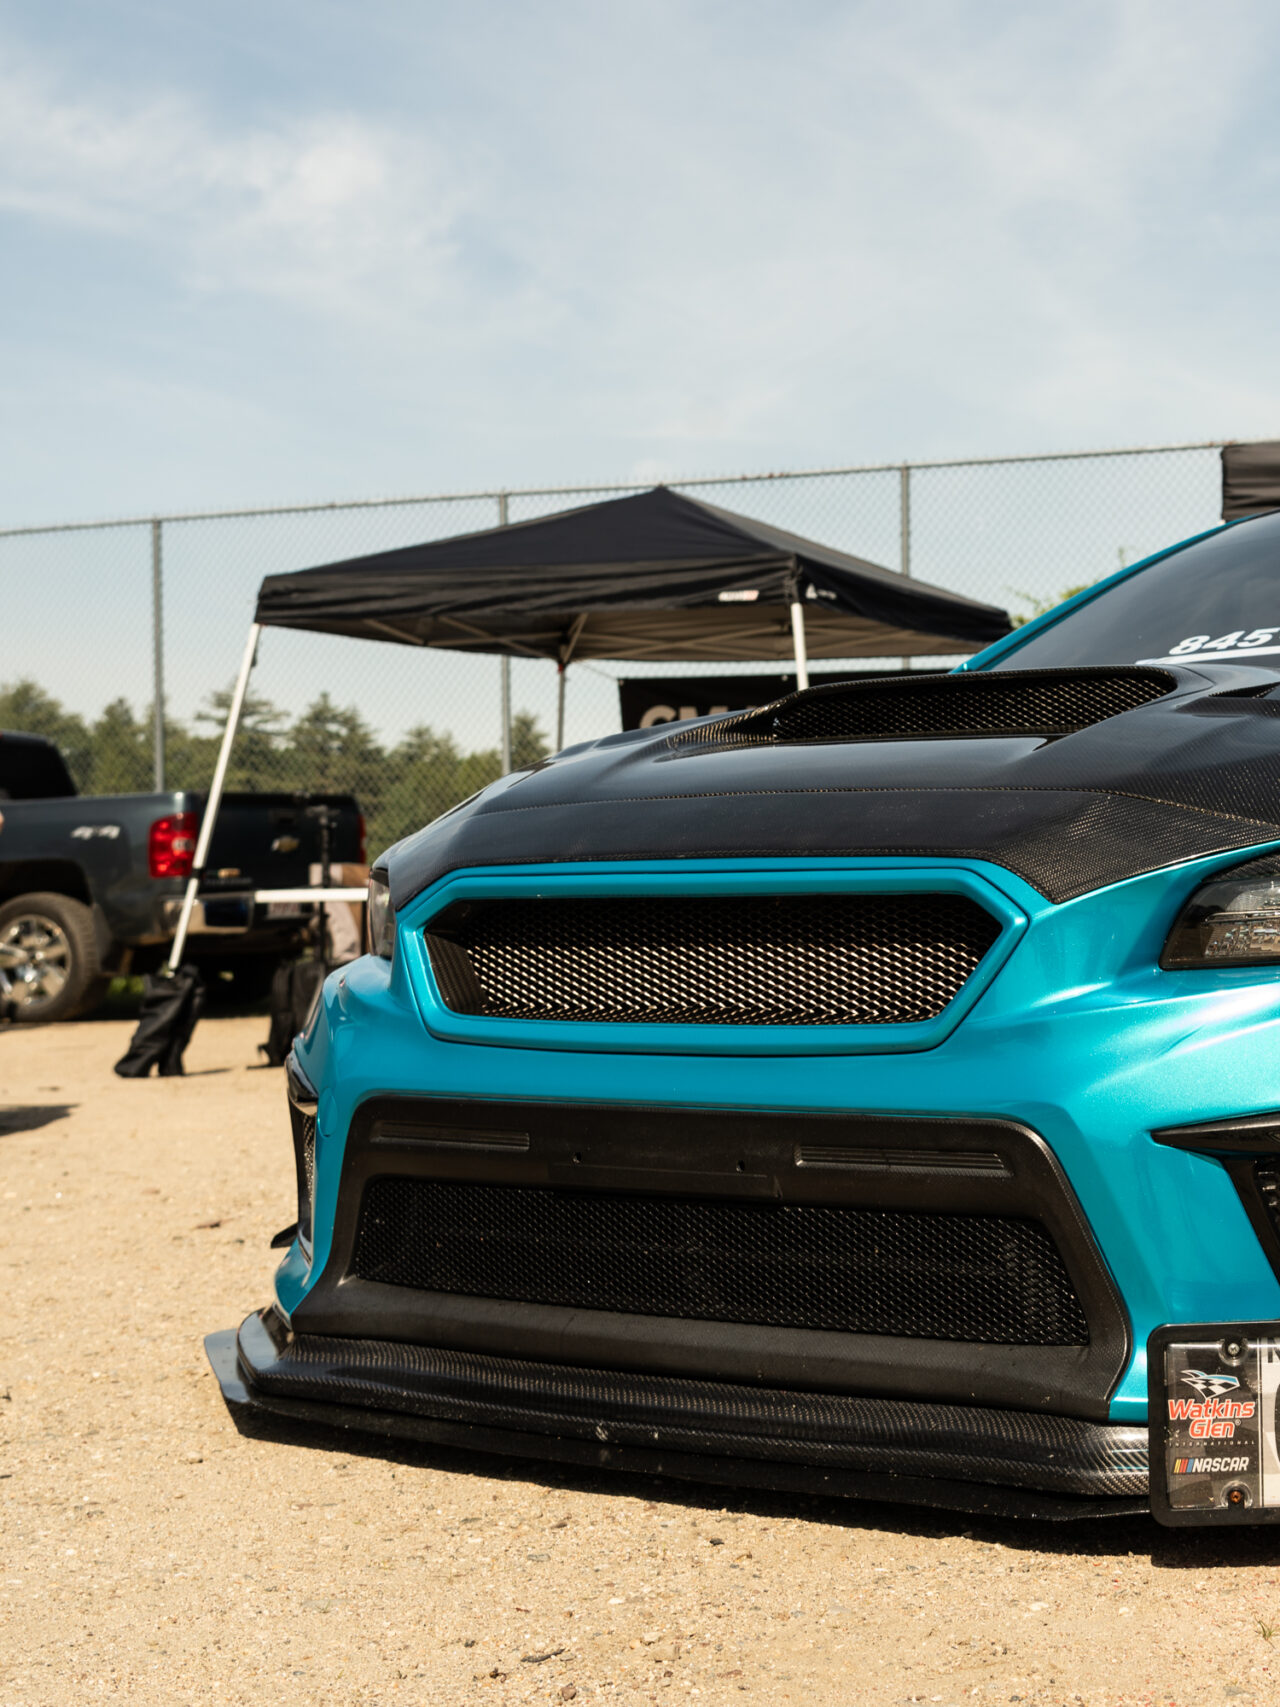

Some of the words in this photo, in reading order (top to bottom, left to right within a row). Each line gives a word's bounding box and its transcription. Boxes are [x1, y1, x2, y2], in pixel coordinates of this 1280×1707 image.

[1169, 627, 1280, 656] 845
[1168, 1398, 1256, 1420] Watkins
[1189, 1418, 1235, 1439] Glen
[1191, 1456, 1250, 1474] NASCAR
